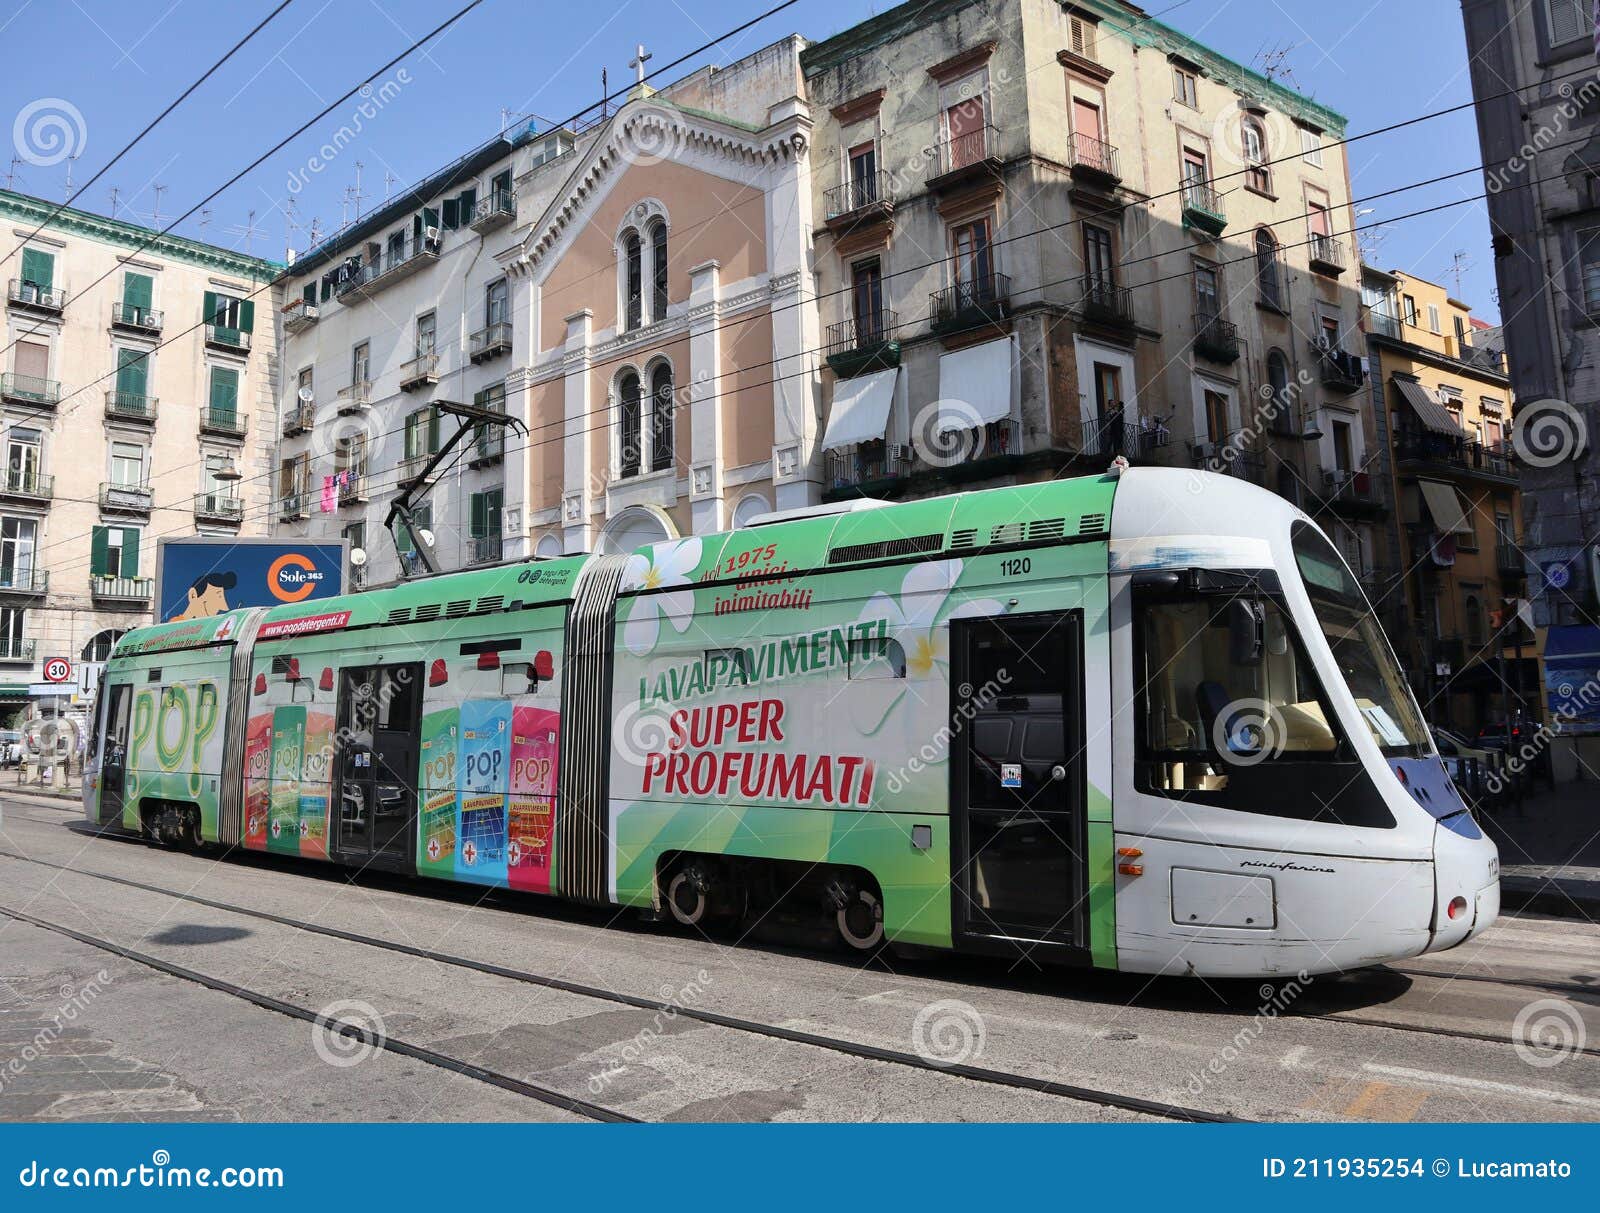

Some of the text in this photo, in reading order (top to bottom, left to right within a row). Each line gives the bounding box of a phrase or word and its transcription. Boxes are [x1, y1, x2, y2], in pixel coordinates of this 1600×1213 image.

[725, 544, 777, 573] 1975
[1001, 557, 1031, 577] 1120
[279, 571, 323, 583] Sole 365
[713, 588, 814, 616] inimitabili
[265, 613, 347, 636] www.popdetergenti.it
[51, 664, 66, 676] 30
[638, 618, 889, 712] LAVAPAVIMENTI
[668, 699, 784, 750] SUPER
[128, 680, 219, 799] POP
[274, 746, 300, 775] POP
[466, 749, 502, 785] POP
[514, 758, 550, 789] POP
[642, 751, 877, 804] PROFUMATI
[1240, 860, 1336, 873] pininfarina
